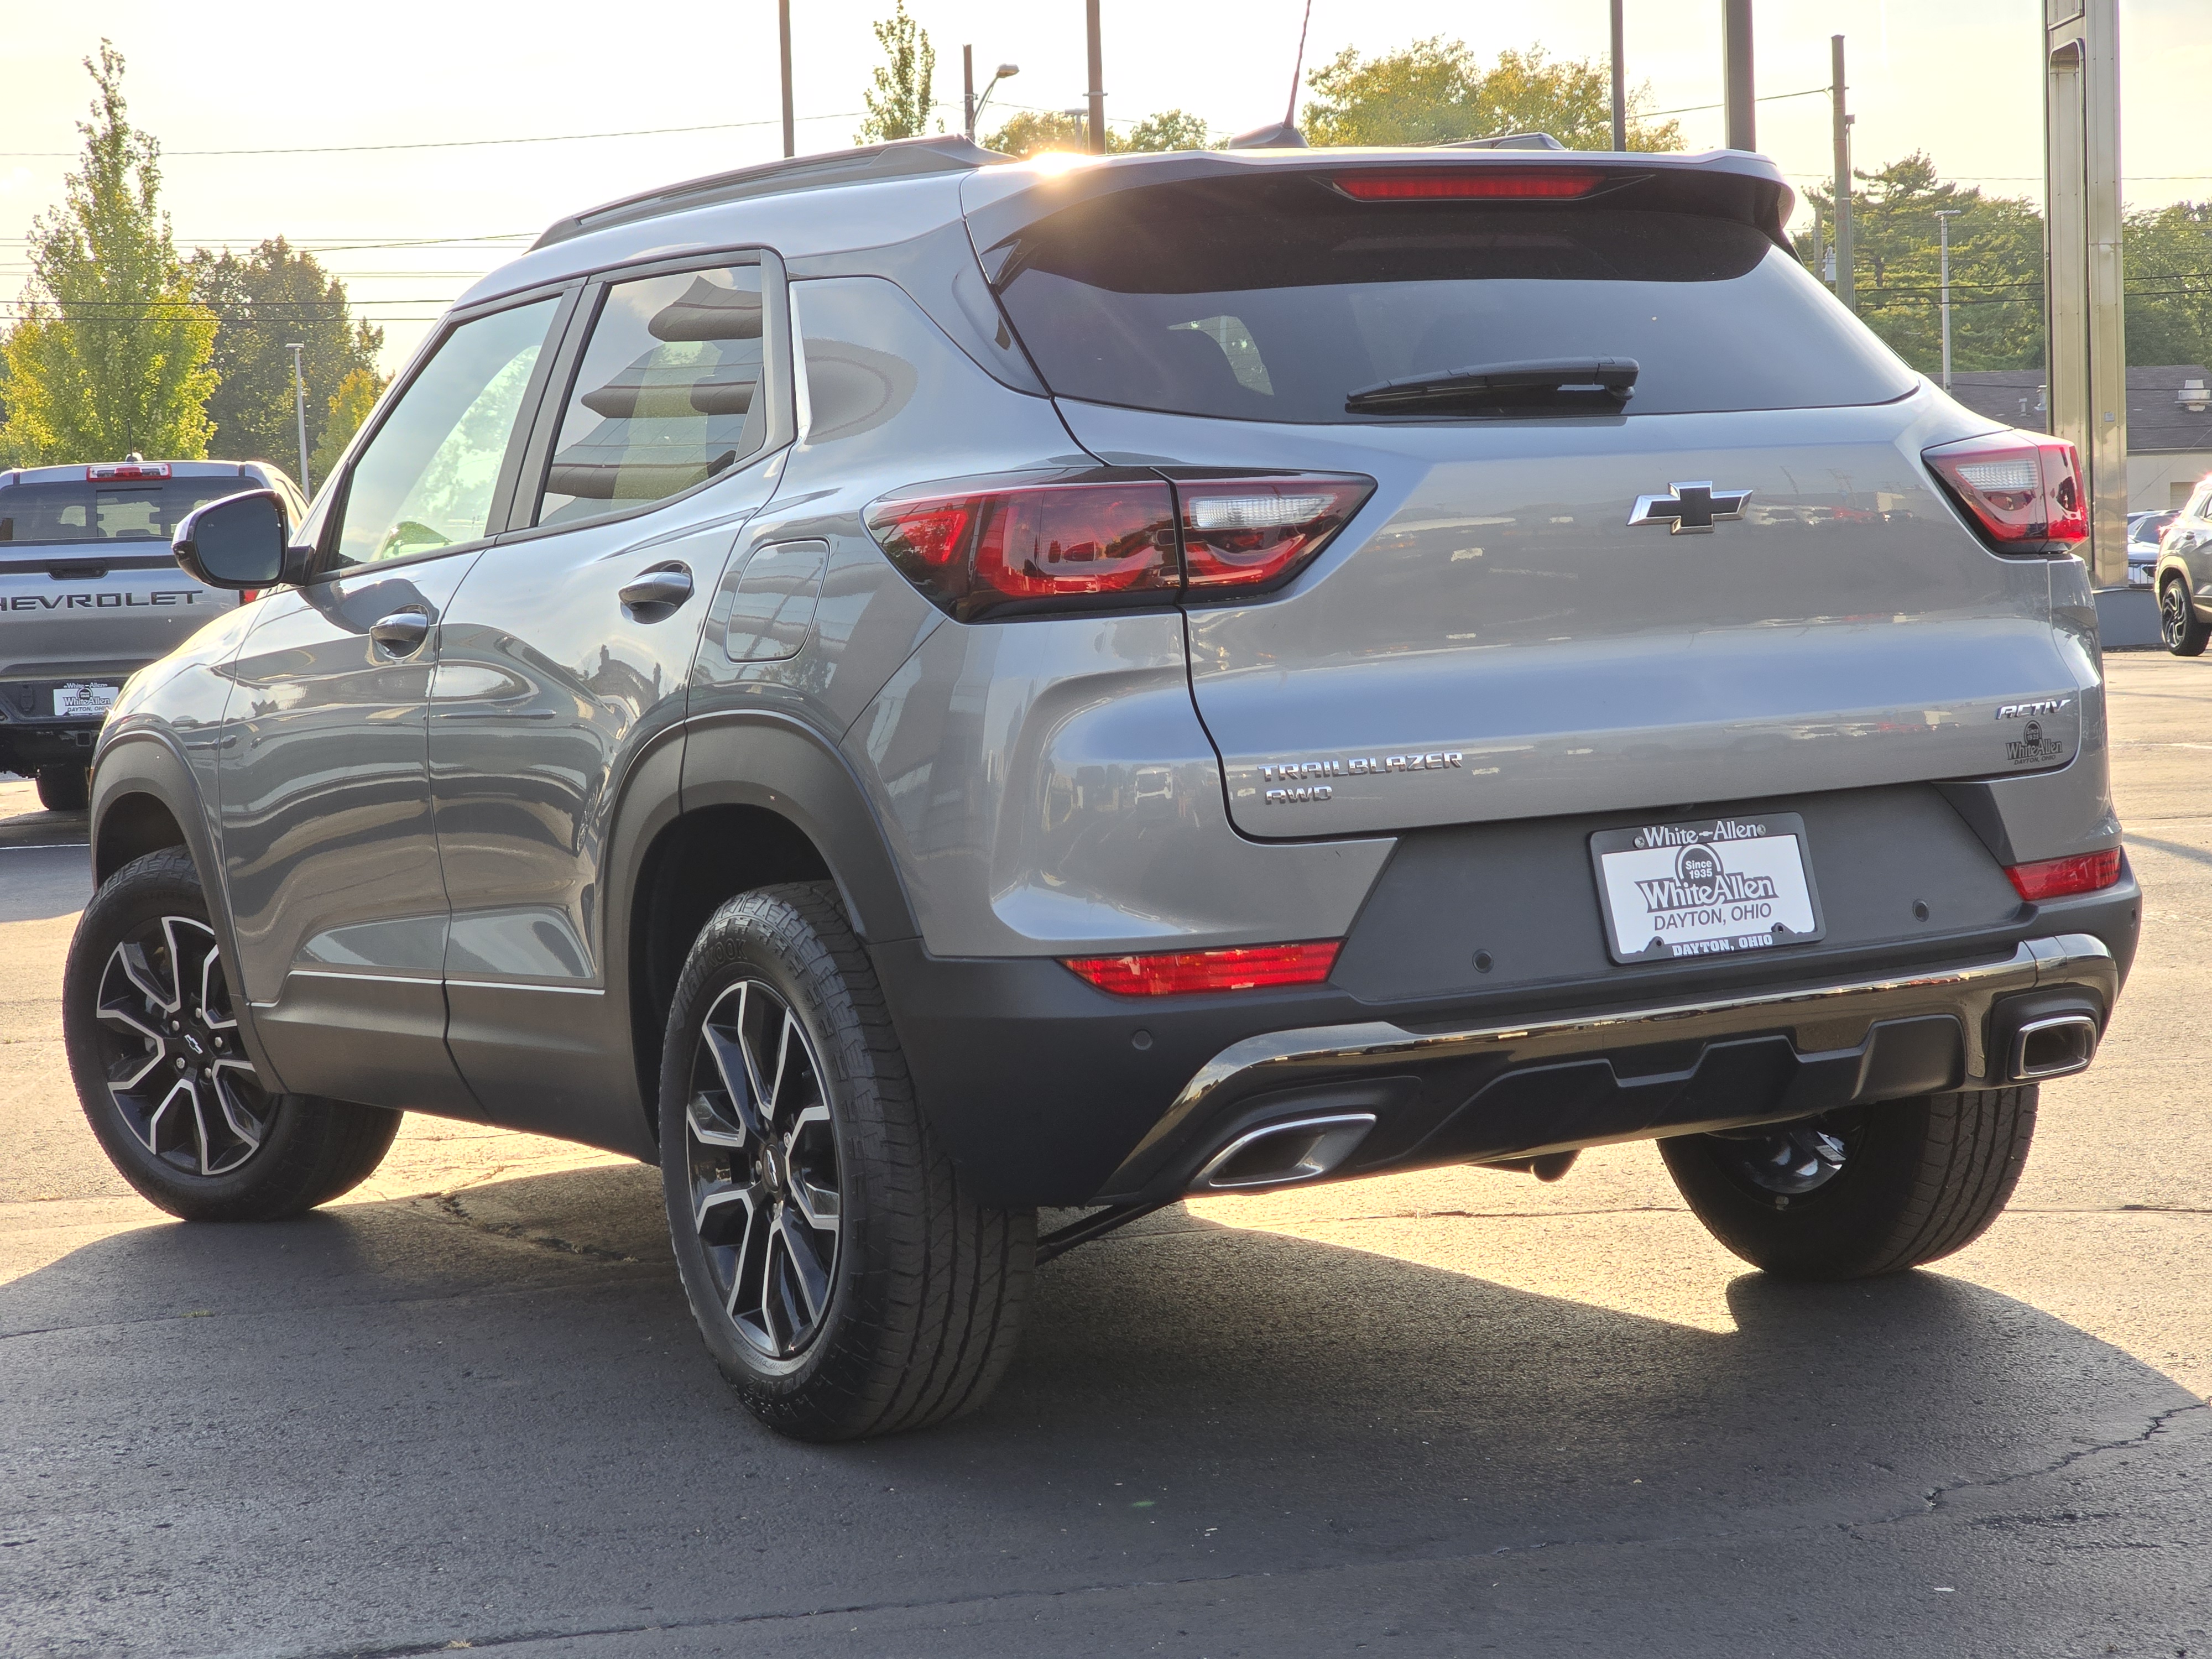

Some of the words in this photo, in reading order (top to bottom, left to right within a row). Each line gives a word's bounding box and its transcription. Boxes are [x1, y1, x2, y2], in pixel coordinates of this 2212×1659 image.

[0, 590, 203, 611] EVROLET
[1996, 699, 2071, 719] ACTIV
[1258, 751, 1463, 782] TRAILBLAZER
[2014, 757, 2040, 765] DAYTON,
[1265, 785, 1332, 805] AWD
[1686, 860, 1712, 870] Since
[1689, 868, 1713, 879] 1935
[1654, 908, 1726, 931] DAYTON,
[1731, 903, 1772, 921] OHIO
[1672, 940, 1735, 957] DAYTON,
[1739, 934, 1773, 948] OHIO
